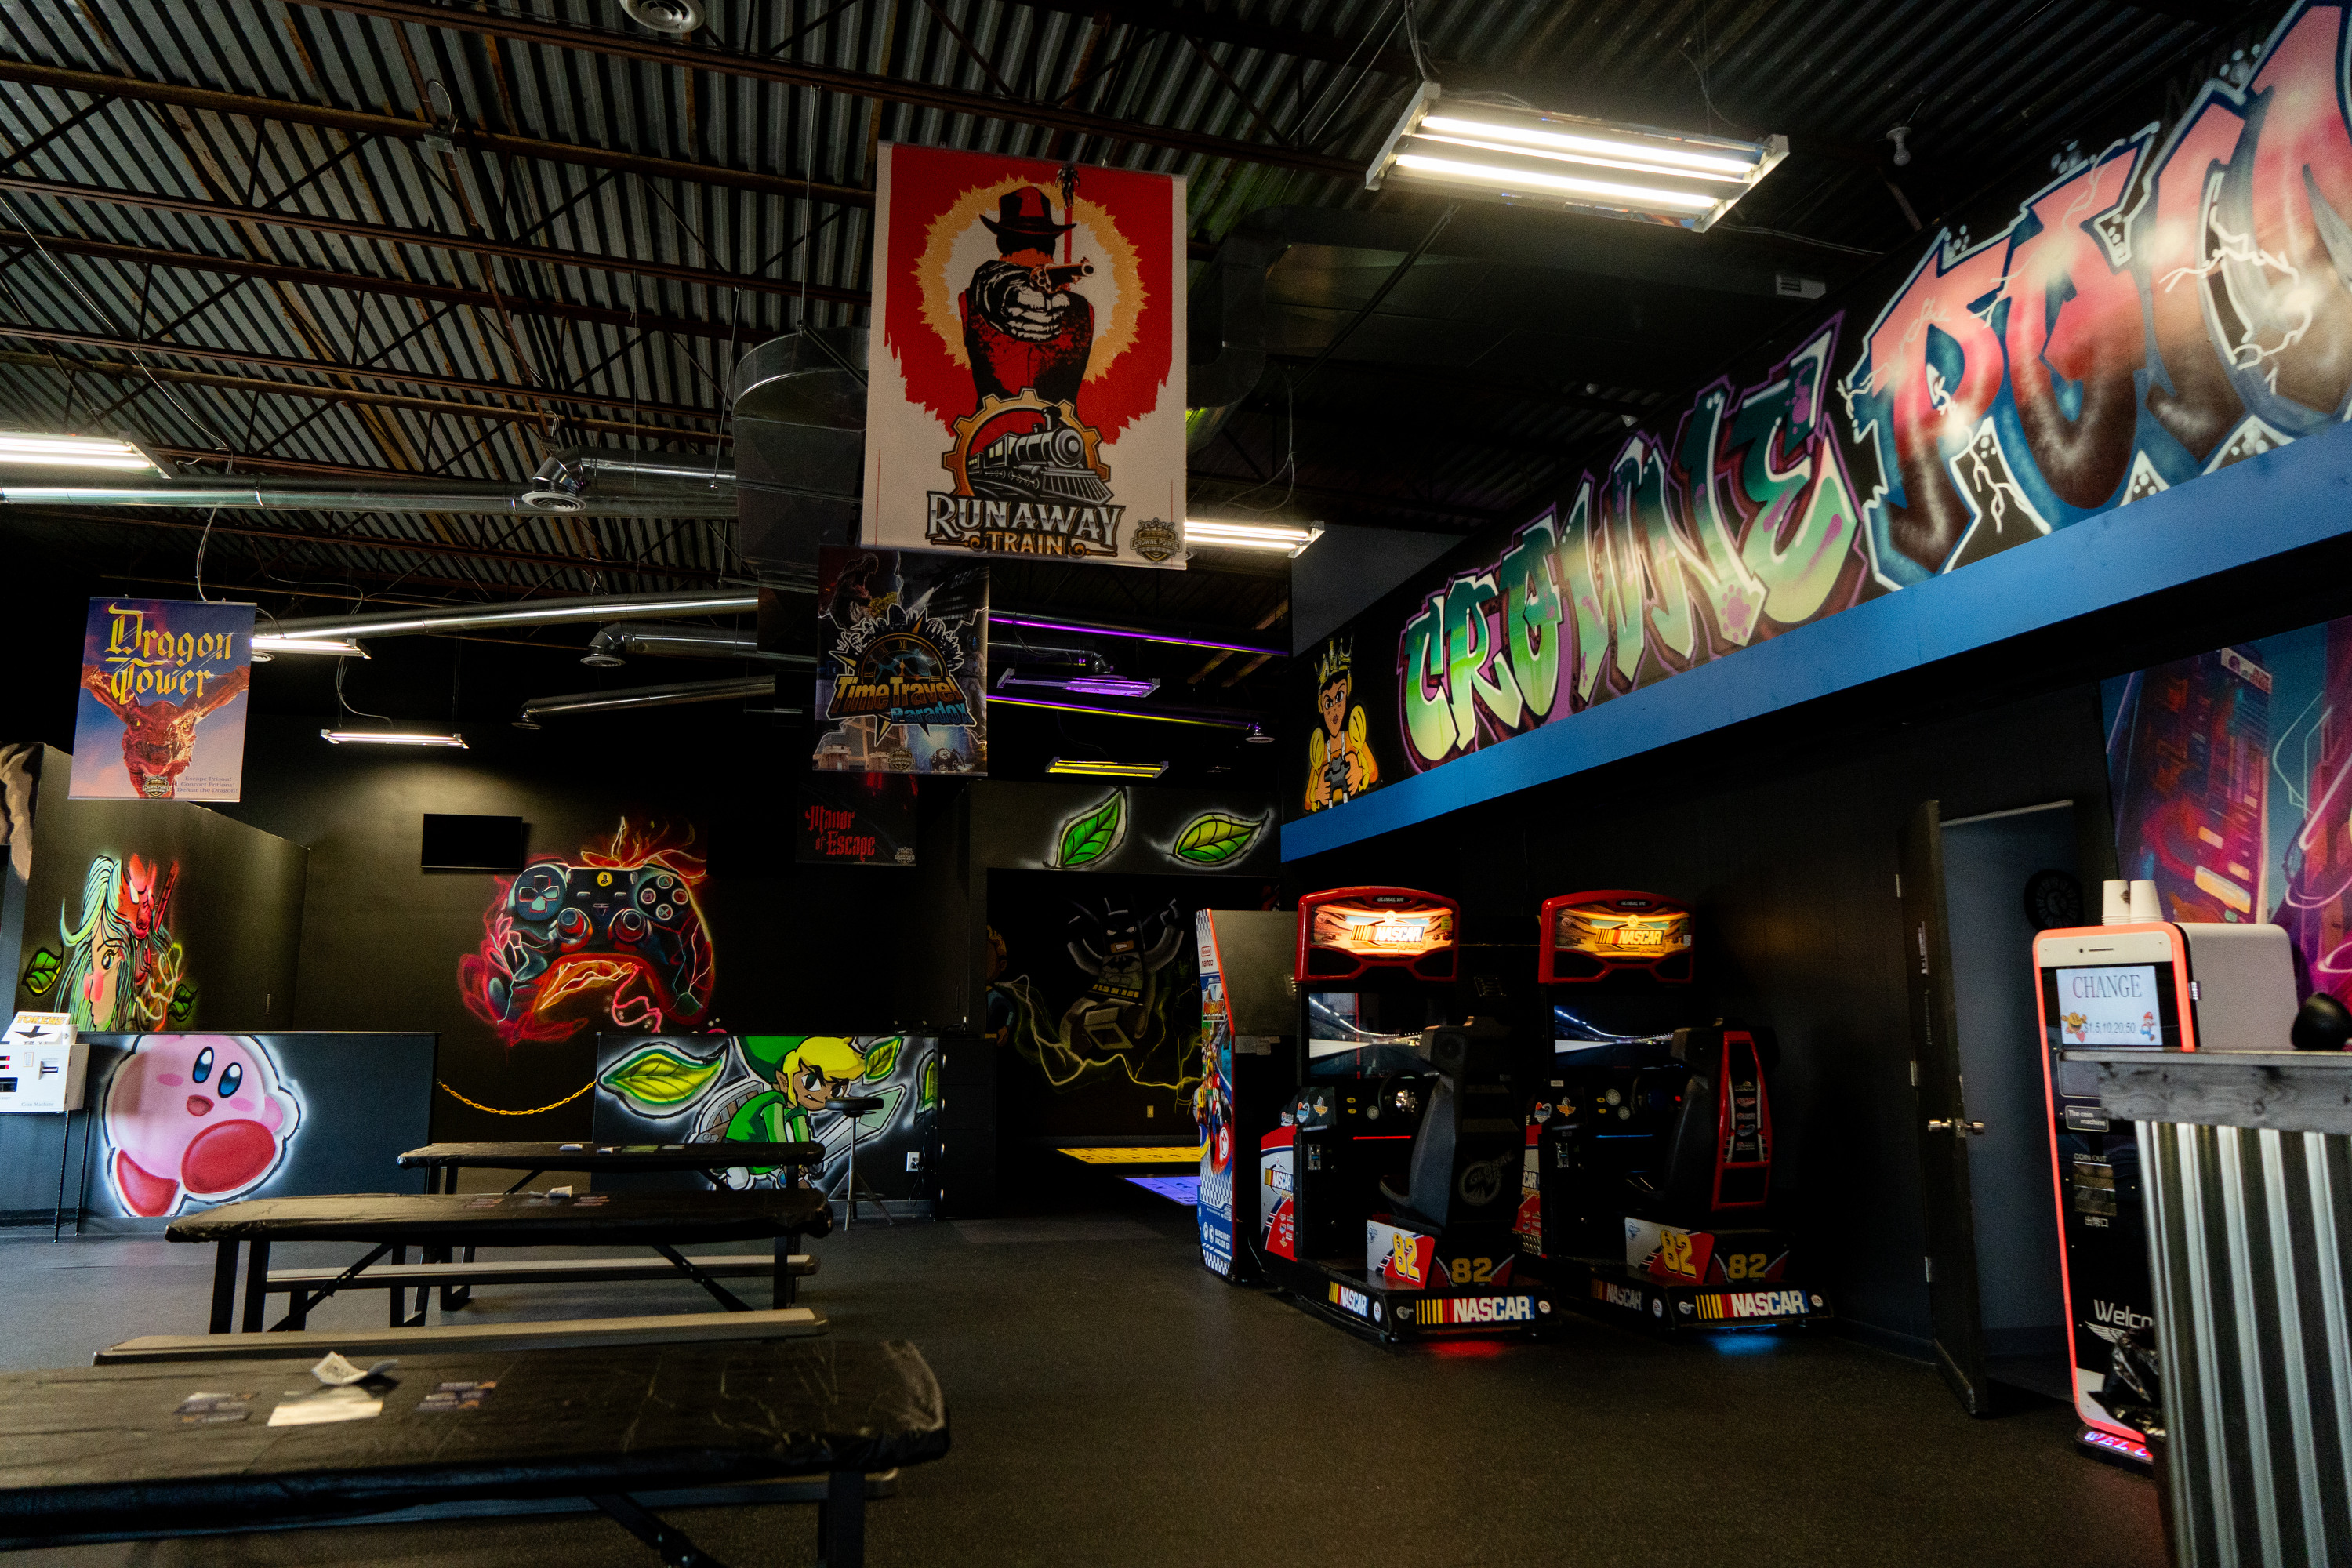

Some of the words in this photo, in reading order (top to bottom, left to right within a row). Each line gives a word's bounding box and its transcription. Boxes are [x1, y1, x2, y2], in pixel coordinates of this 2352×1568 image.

[927, 492, 1125, 546] RUNAWAY
[985, 532, 1065, 555] TRAIN
[1398, 312, 1867, 775] CROWNE
[104, 602, 232, 667] Dragon
[104, 656, 212, 705] Tower
[831, 676, 889, 714] Time
[890, 676, 964, 706] Travel
[891, 702, 971, 724] Paradox
[804, 805, 855, 833] Manor
[815, 836, 826, 850] of
[826, 830, 876, 862] Escape
[1374, 926, 1422, 942] NASCAR
[1617, 930, 1663, 945] NASCAR
[2072, 974, 2143, 999] CHANGE
[16, 1015, 67, 1025] TOKENS
[1272, 1171, 1292, 1192] NASCAR
[1392, 1232, 1421, 1283] 82
[1660, 1230, 1697, 1279] 82
[1727, 1253, 1768, 1279] 82
[1451, 1257, 1493, 1284] 82
[1340, 1285, 1368, 1318] NASCAR
[1453, 1296, 1532, 1323] NASCAR
[1606, 1283, 1643, 1312] NASCAR
[1730, 1290, 1806, 1318] NASCAR
